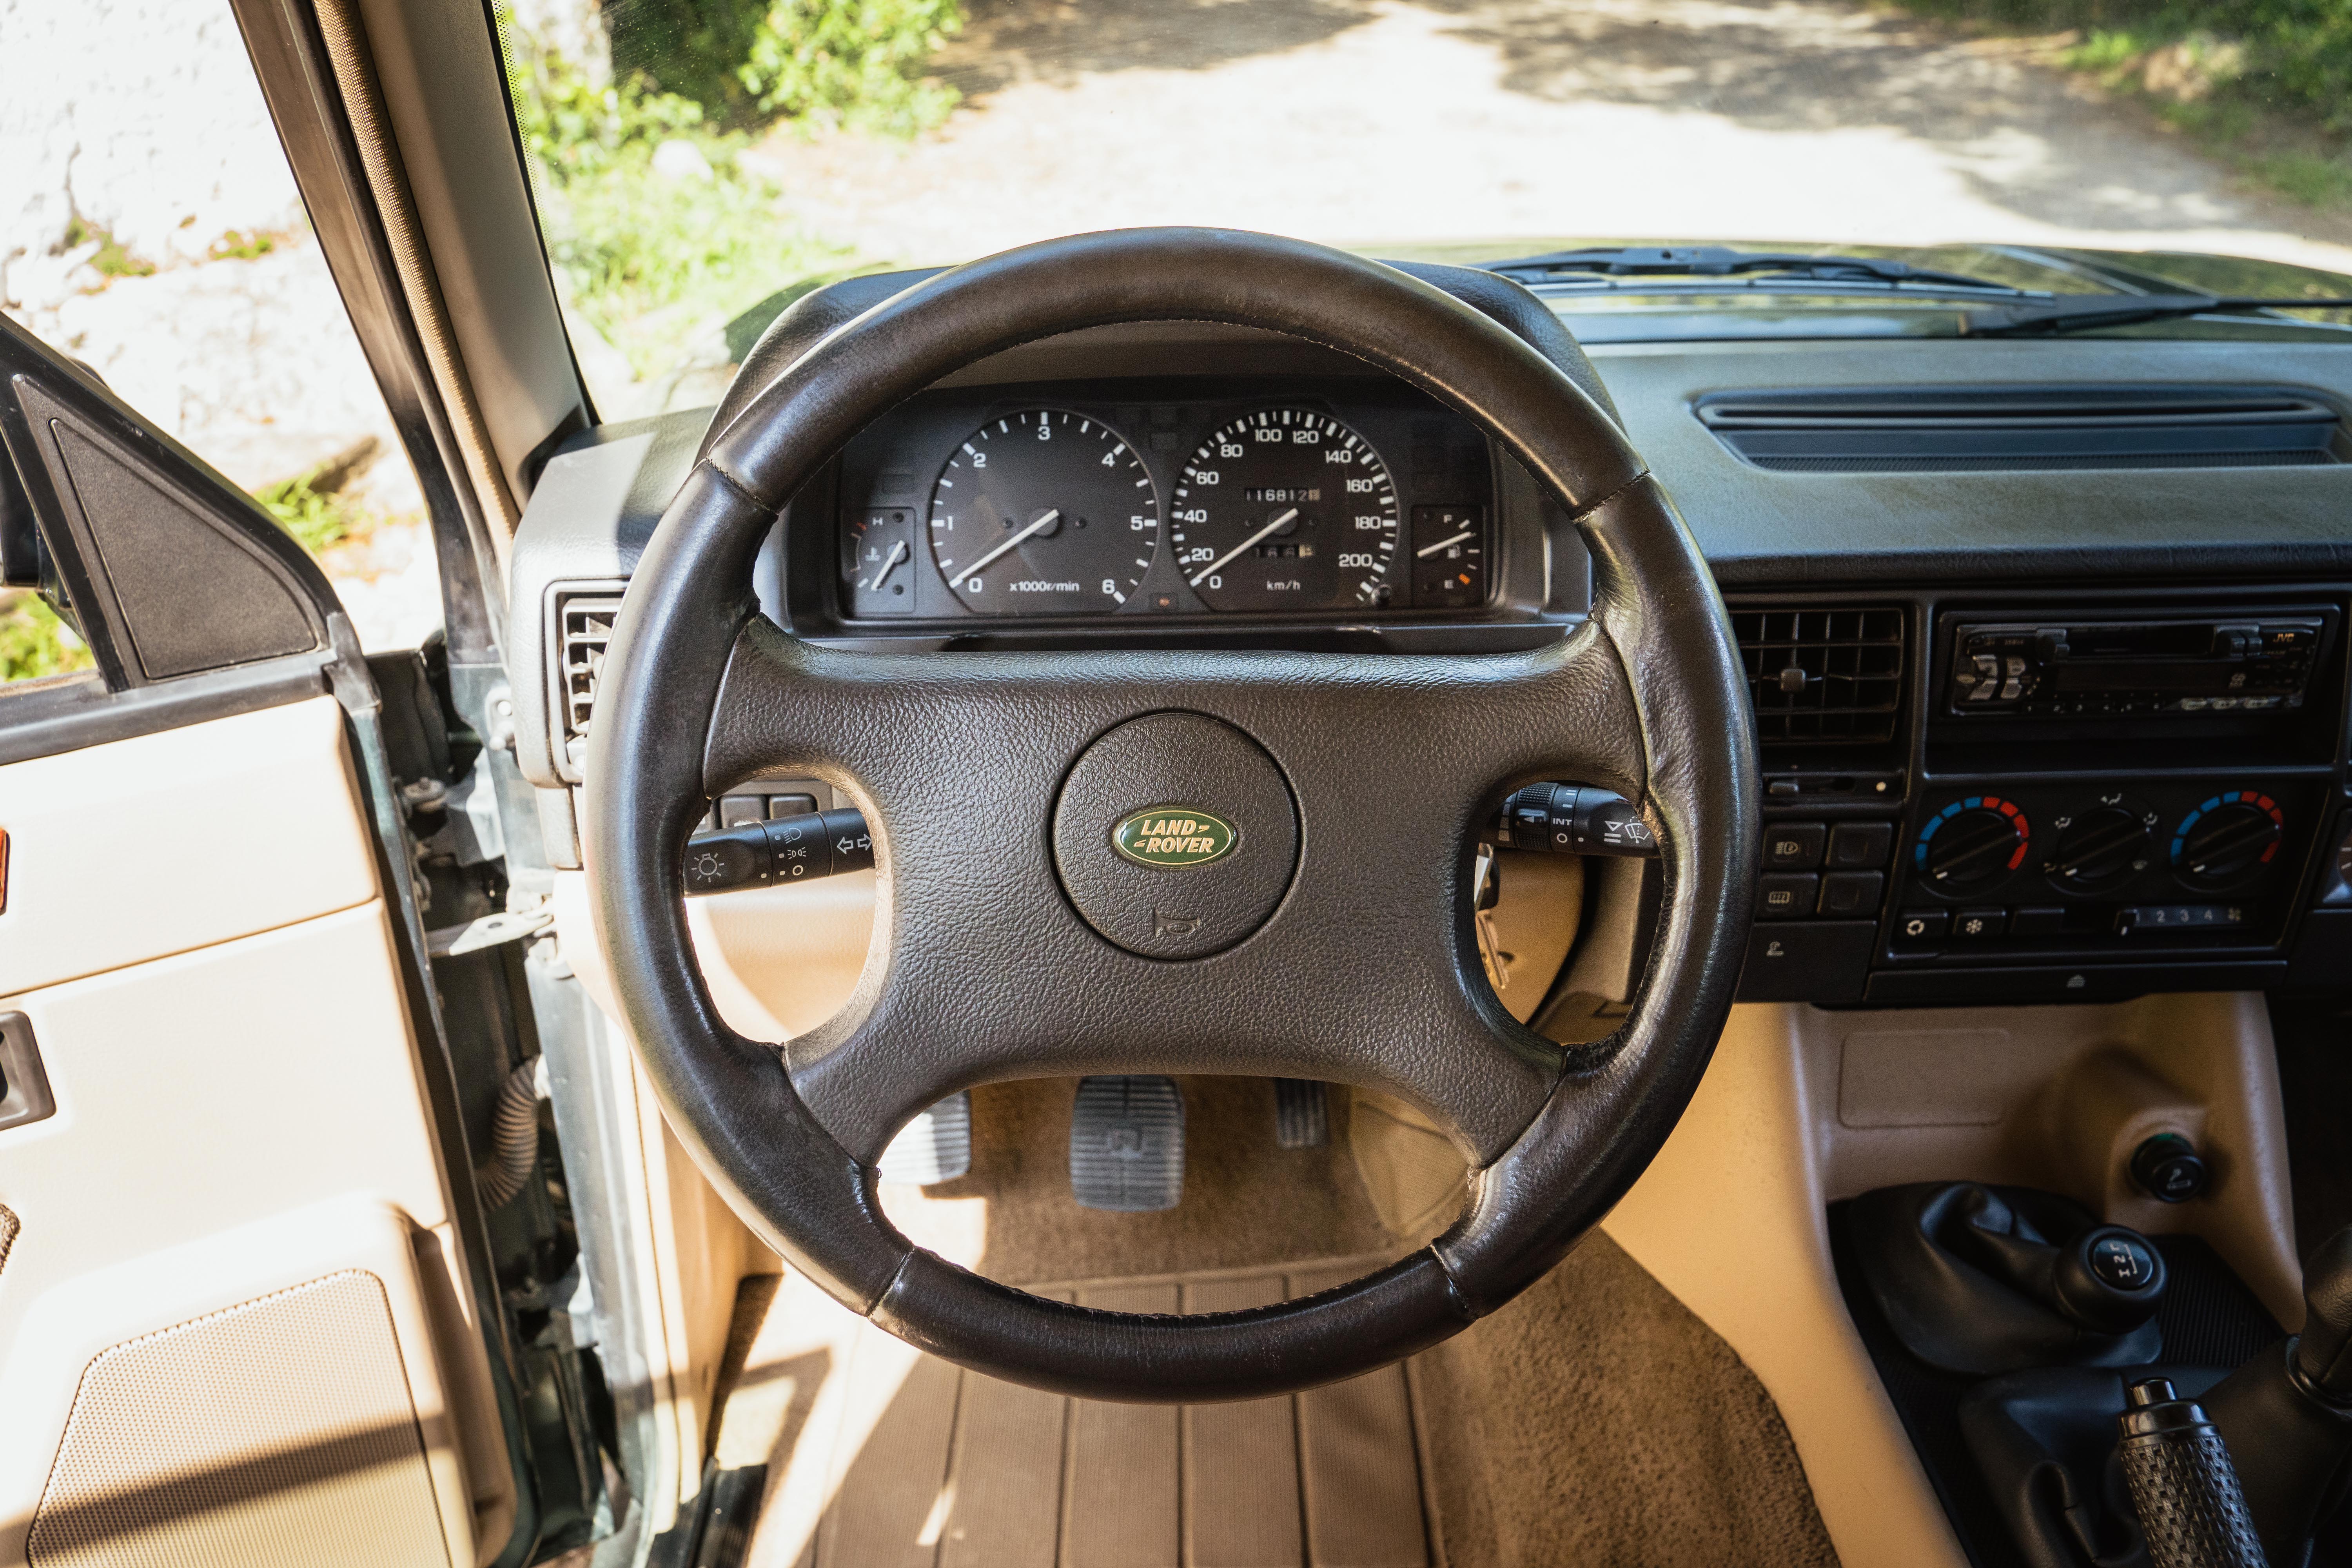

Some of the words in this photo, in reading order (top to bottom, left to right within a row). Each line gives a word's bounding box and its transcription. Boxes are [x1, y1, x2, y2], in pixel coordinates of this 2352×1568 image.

[1038, 426, 1050, 440] 3
[1255, 429, 1282, 442] 100
[1293, 431, 1319, 443] 120
[1221, 444, 1243, 457] 80
[1326, 450, 1352, 463] 140
[973, 453, 985, 468] 2
[1102, 452, 1114, 467] 4
[1196, 471, 1219, 485] 60
[1347, 479, 1373, 492] 160
[873, 517, 883, 526] H
[947, 516, 953, 530] 1
[1131, 516, 1143, 530] 5
[1184, 510, 1207, 523] 40
[1355, 516, 1381, 529] 180
[1192, 548, 1214, 561] 20
[1339, 554, 1372, 567] 200
[969, 578, 982, 592] 0
[1102, 579, 1115, 593] 6
[1210, 576, 1221, 589] 0
[1267, 581, 1300, 590] km/h
[2272, 633, 2295, 642] JVC
[1141, 820, 1196, 835] LAND
[1145, 837, 1214, 853] ROVER
[2156, 910, 2165, 922] 2
[2180, 909, 2189, 922] 3
[2204, 910, 2212, 920] 4
